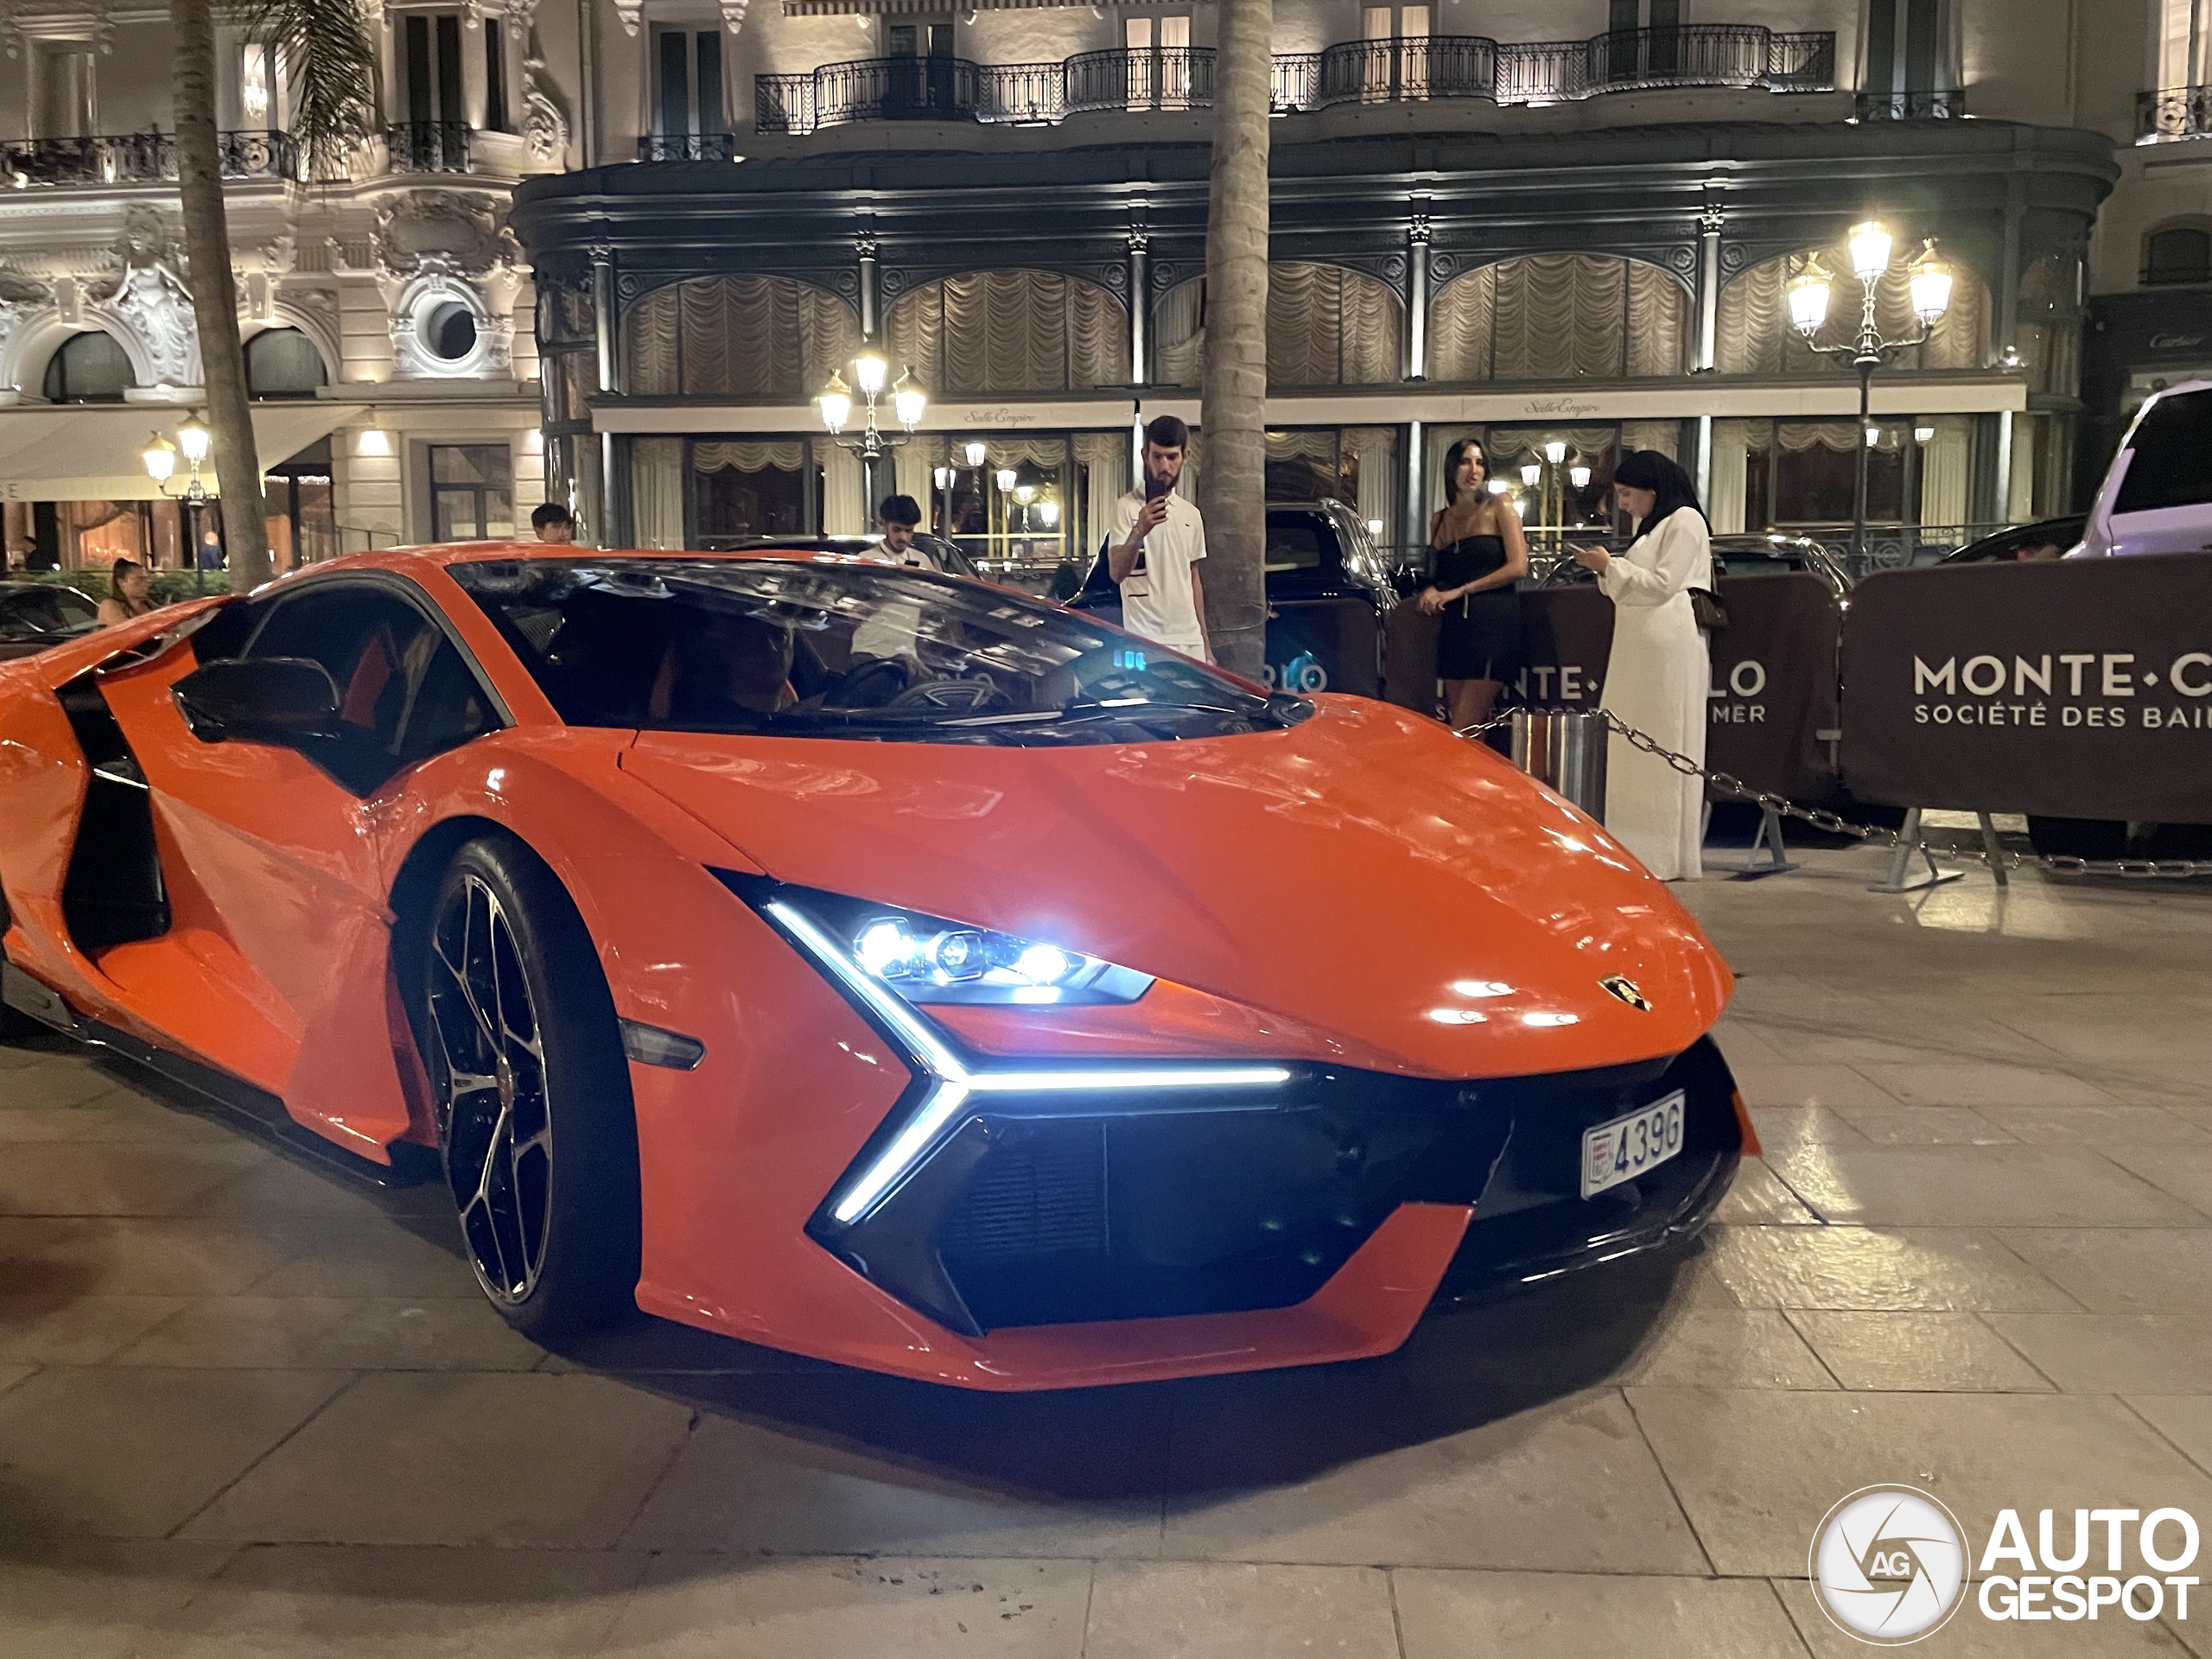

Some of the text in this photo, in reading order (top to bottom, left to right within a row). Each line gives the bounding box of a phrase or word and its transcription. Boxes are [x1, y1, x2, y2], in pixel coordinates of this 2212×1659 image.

[963, 408, 1036, 427] Salle Empire
[1712, 703, 1765, 723] MER
[1914, 700, 2212, 728] SOCIÉTÉ DES BAI
